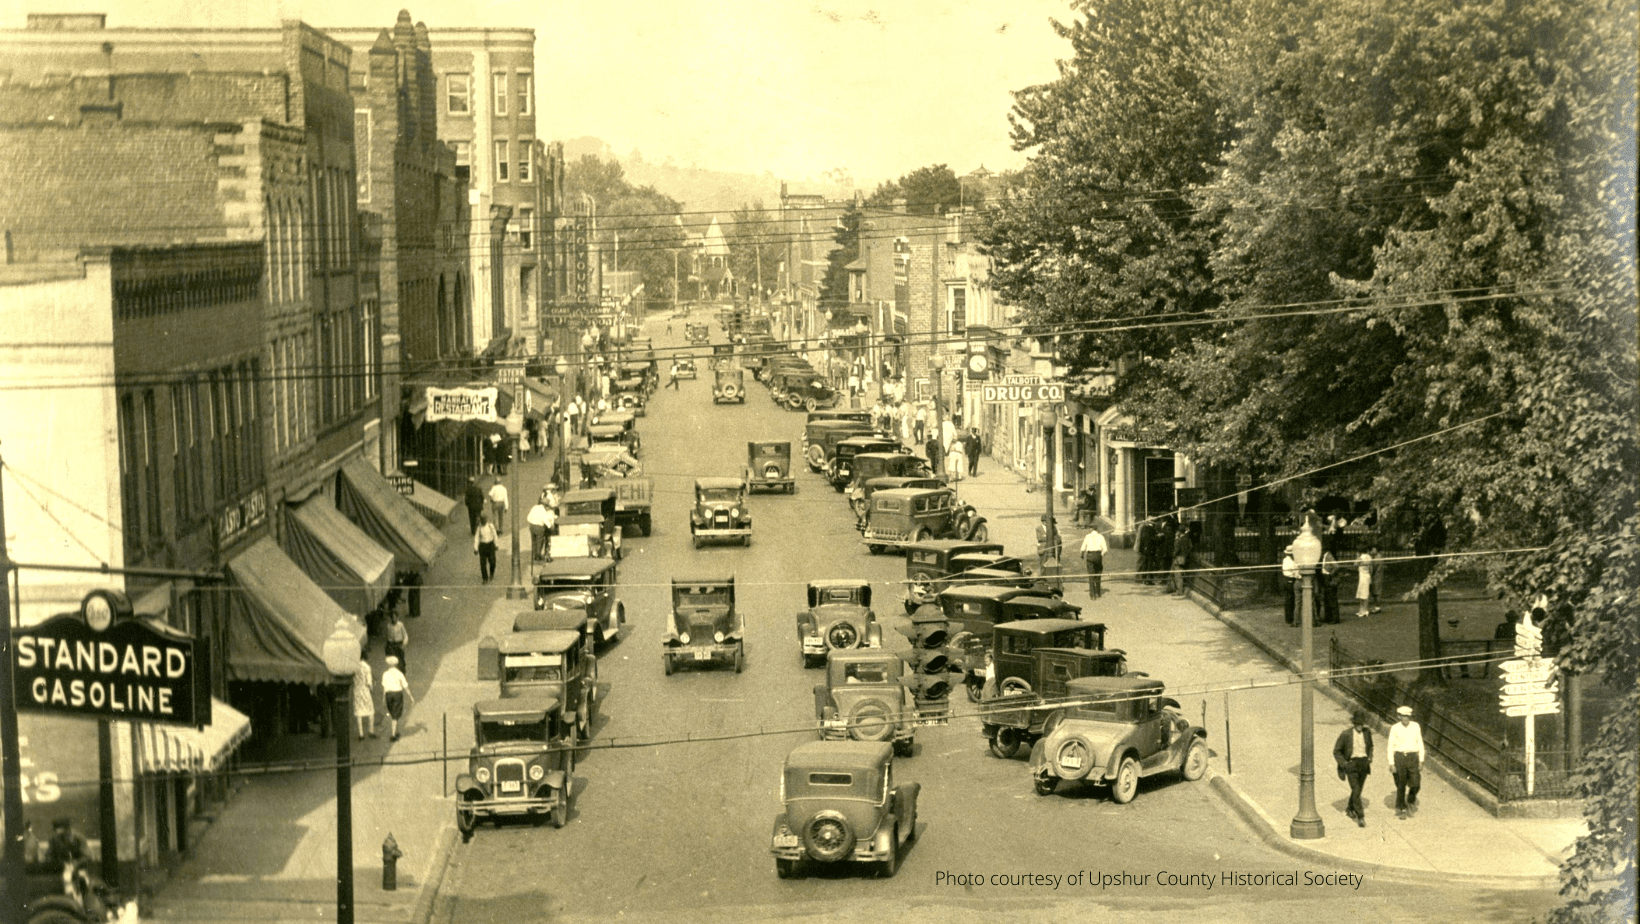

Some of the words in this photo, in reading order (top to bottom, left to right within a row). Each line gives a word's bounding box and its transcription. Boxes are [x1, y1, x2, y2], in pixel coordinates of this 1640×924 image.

[1007, 377, 1039, 385] TALBOTT
[440, 394, 482, 405] MANHATTAN
[985, 386, 1032, 401] DRUG
[1038, 386, 1062, 400] CO.
[434, 401, 489, 415] RESTAURANT
[18, 635, 186, 679] STANDARD
[32, 676, 174, 714] GASOLINE
